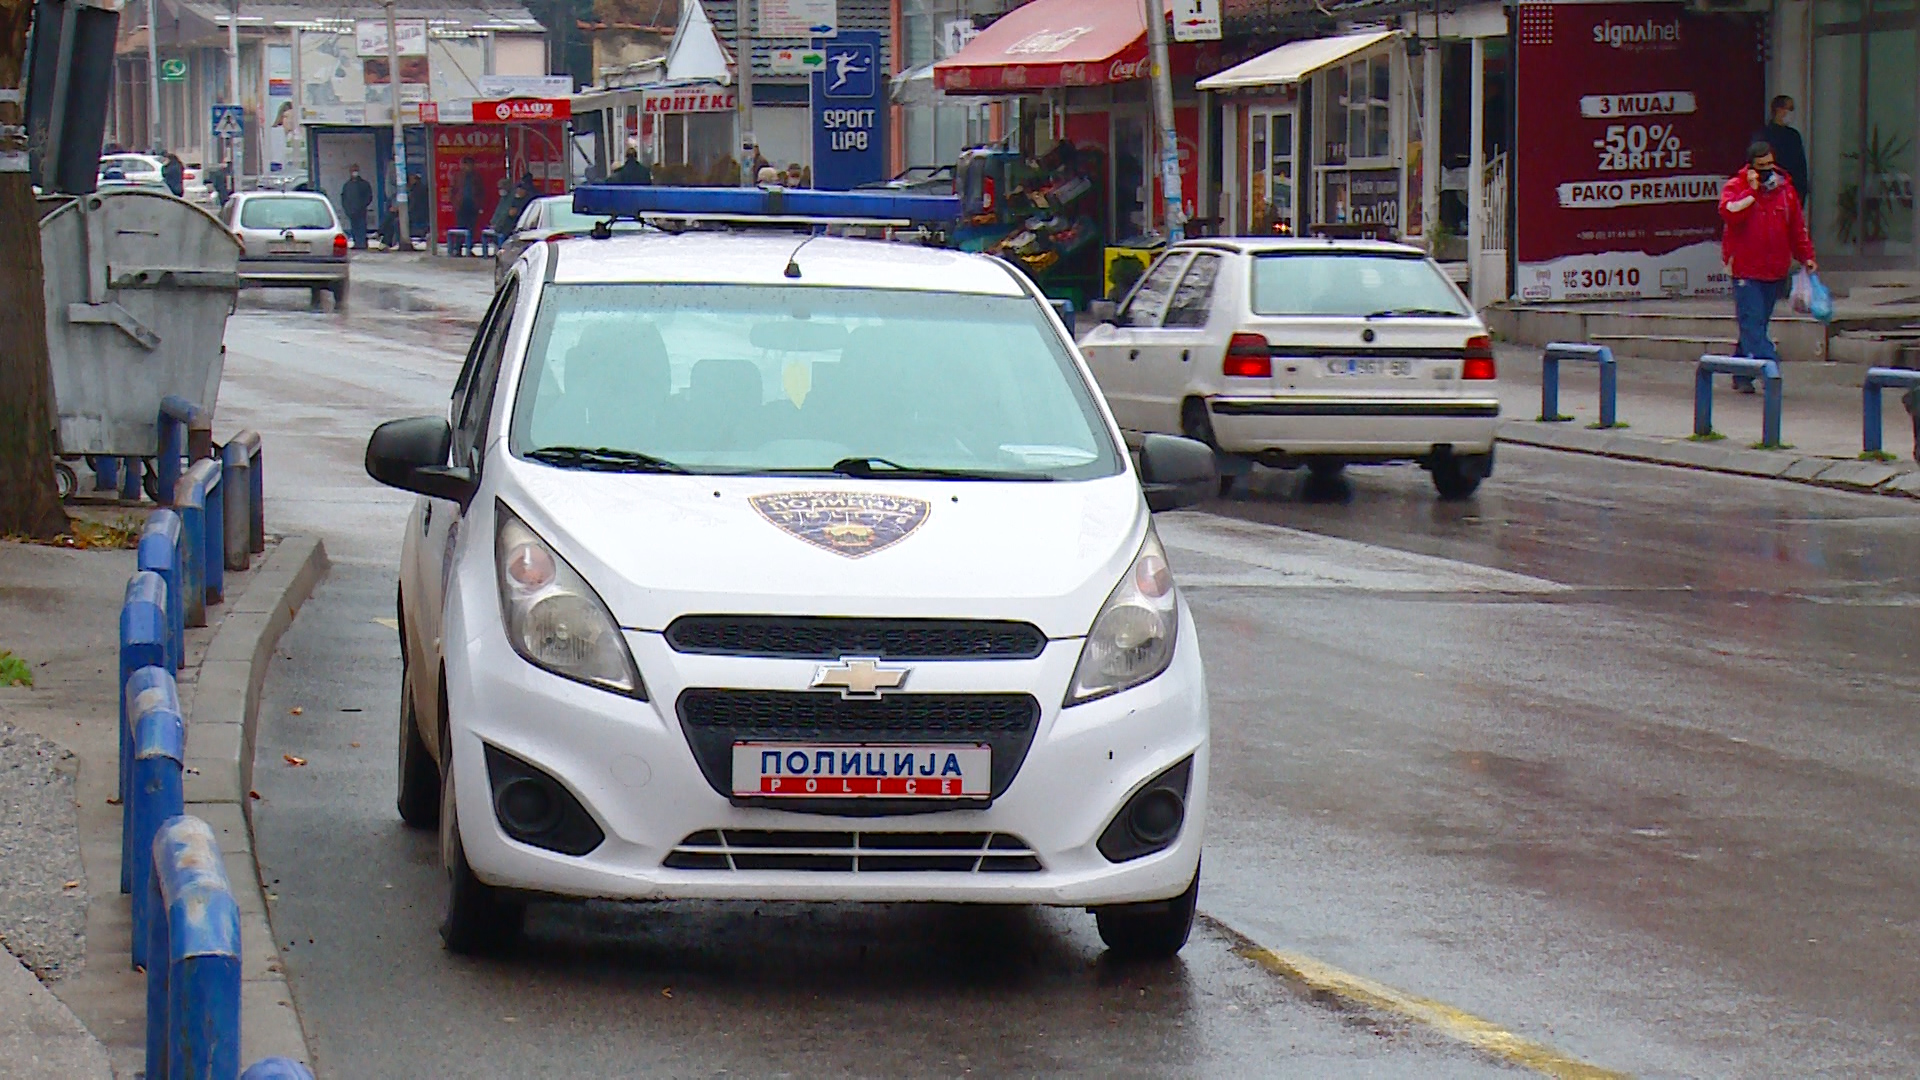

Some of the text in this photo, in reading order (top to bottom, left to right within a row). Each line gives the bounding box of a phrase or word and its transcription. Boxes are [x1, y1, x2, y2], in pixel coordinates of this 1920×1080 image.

[1600, 97, 1675, 114] 3 MUAJ
[1593, 122, 1681, 152] -50%
[1598, 151, 1693, 171] ZBRITJE
[1571, 180, 1719, 202] PAKO PREMIUM
[1581, 267, 1640, 289] 30/10
[761, 750, 962, 776] ПОЛИЦИЈА
[770, 778, 952, 794] POLICE
